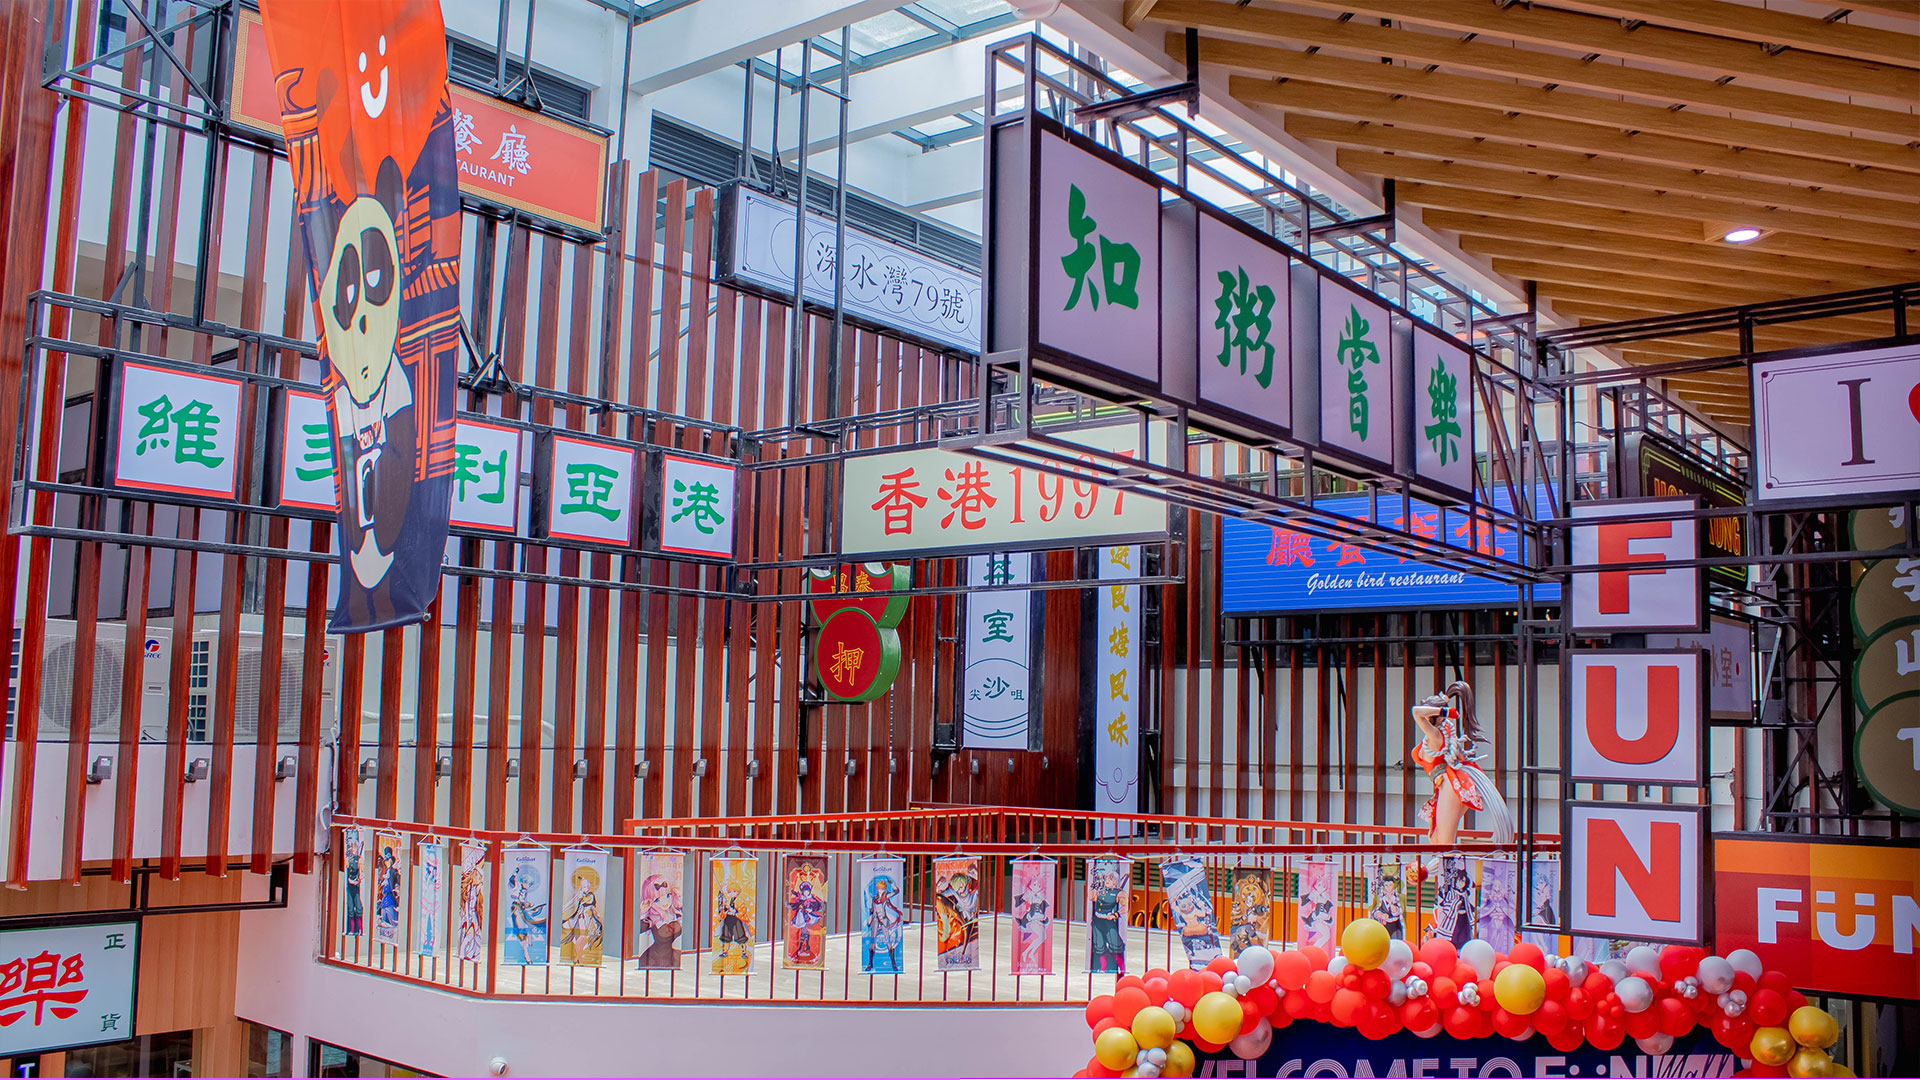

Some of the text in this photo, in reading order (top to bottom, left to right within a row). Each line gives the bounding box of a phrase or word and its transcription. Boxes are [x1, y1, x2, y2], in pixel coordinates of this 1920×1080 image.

[453, 108, 532, 175] 餐廳
[1837, 378, 1876, 467] I
[871, 448, 1134, 536] 香港1997
[1307, 571, 1465, 595] Golden bird restaurant
[969, 676, 1025, 701] 尖沙咀
